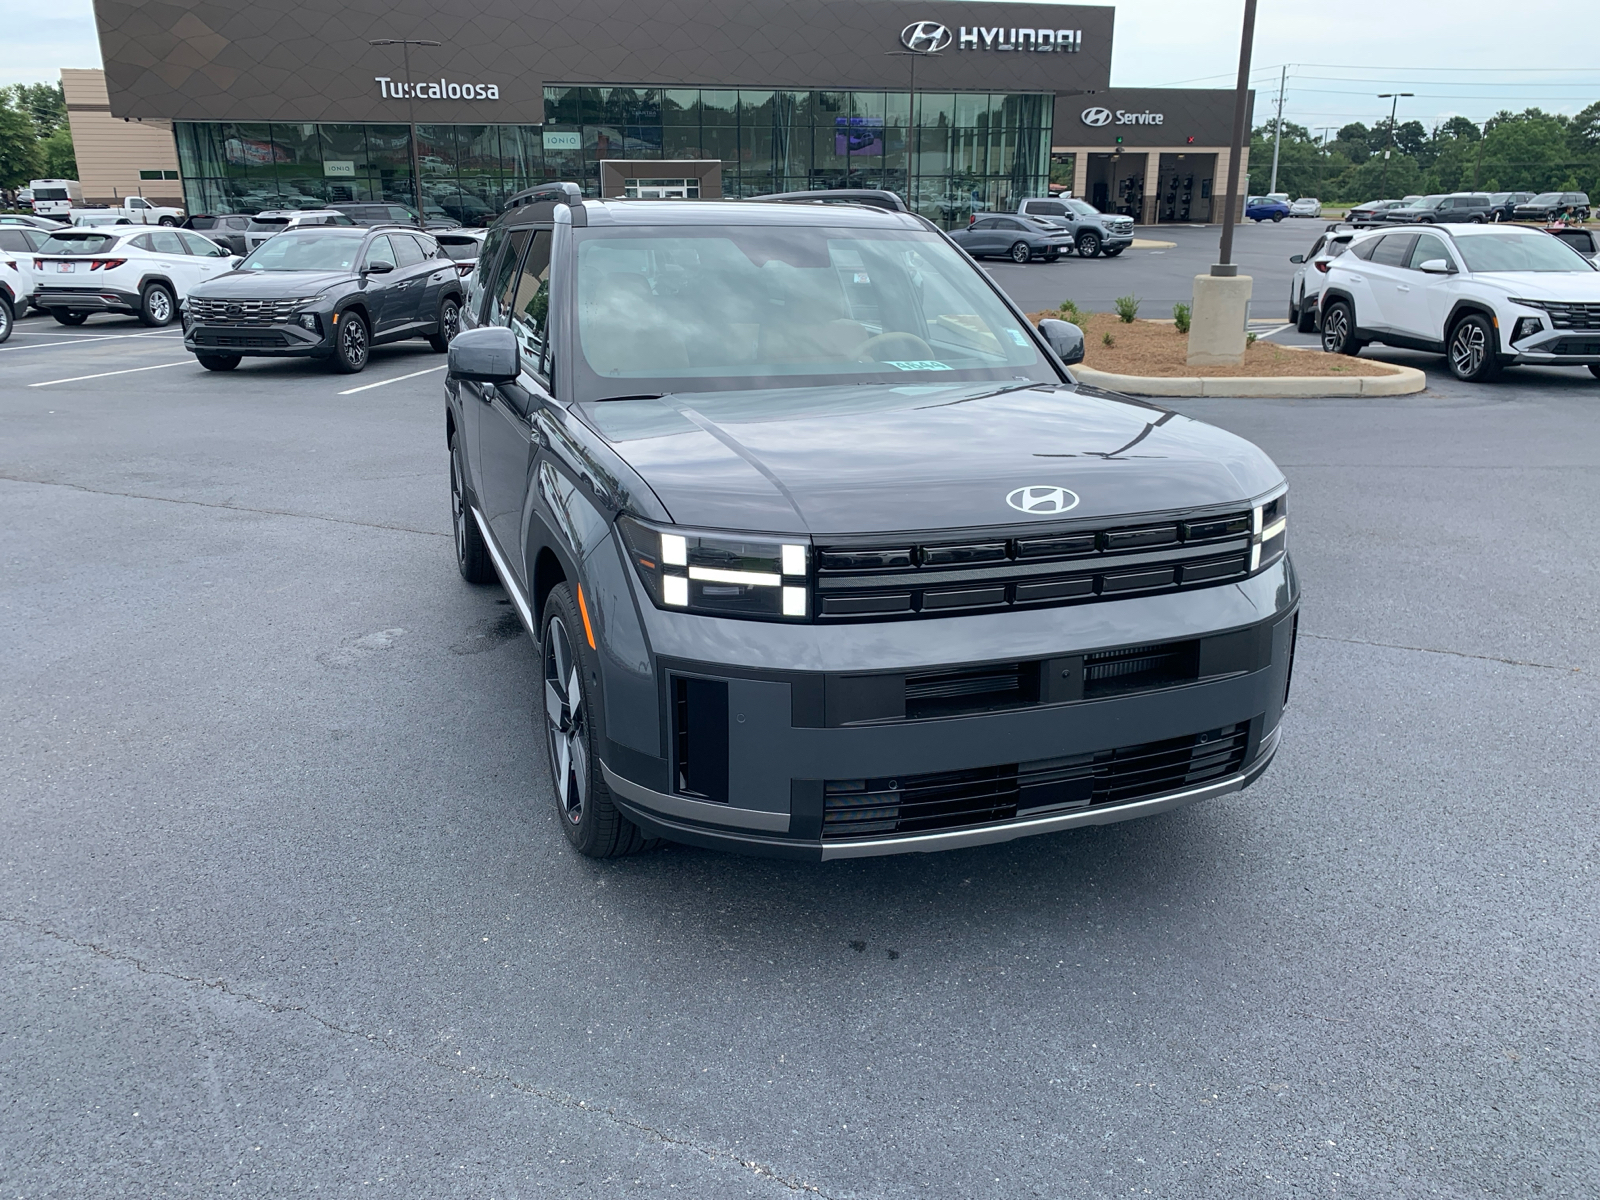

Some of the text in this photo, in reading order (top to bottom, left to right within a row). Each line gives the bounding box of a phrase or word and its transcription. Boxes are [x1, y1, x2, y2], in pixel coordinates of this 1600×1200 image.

[959, 26, 1082, 52] HYUNDAI
[374, 77, 499, 100] Tuscaloosa
[1115, 110, 1164, 125] Service
[547, 136, 576, 144] IONIQ
